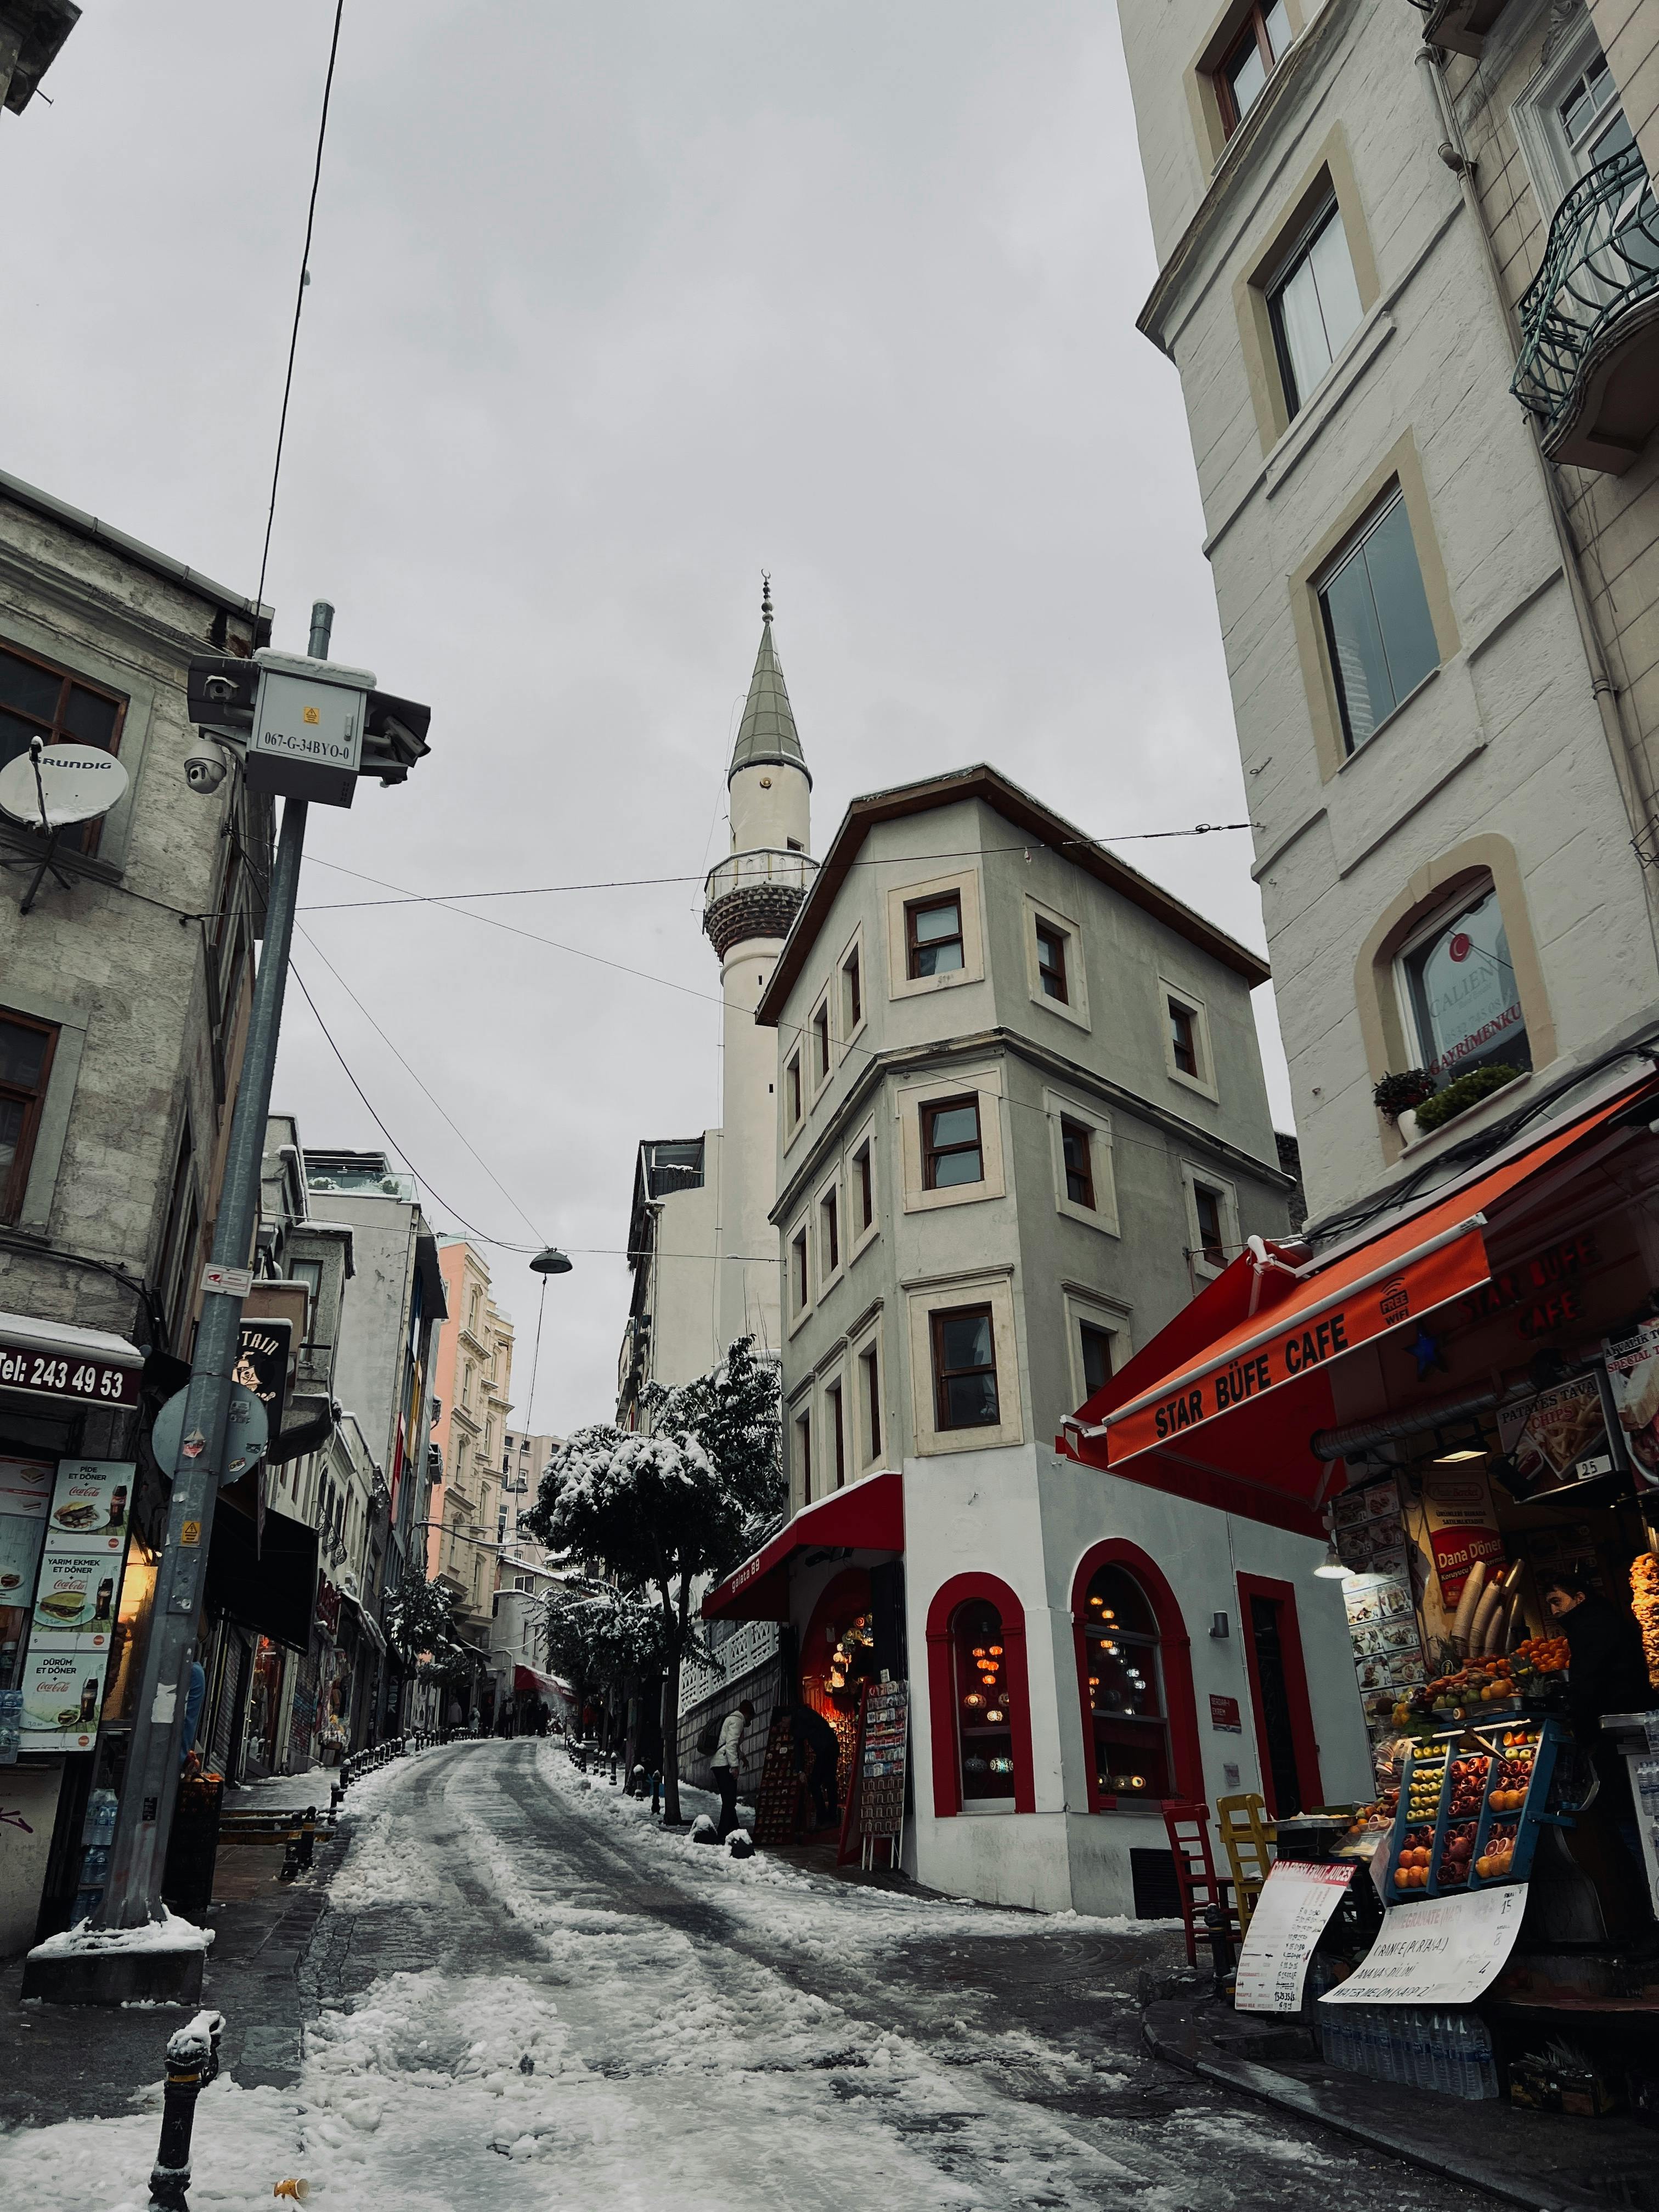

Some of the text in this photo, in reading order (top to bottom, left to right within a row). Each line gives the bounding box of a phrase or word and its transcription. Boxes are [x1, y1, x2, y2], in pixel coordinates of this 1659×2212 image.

[265, 731, 349, 759] 067-G-34BYO-0
[1381, 1291, 1408, 1313] FREE
[237, 1330, 279, 1356] TAIN
[1607, 1350, 1652, 1372] SPECIAL
[30, 1358, 68, 1388] 243
[72, 1365, 96, 1392] 49
[100, 1370, 123, 1398] 53
[1155, 1313, 1348, 1438] STAR BÜFE CAFE
[1502, 1380, 1598, 1424] PATATES TAVA
[1531, 1406, 1573, 1429] CHIPS
[1582, 1460, 1598, 1477] 25
[1437, 1538, 1502, 1568] Dana Döner
[732, 1558, 760, 1593] galata 89
[1308, 1863, 1331, 1881] FRUIT
[1325, 1865, 1355, 1882] JUICES
